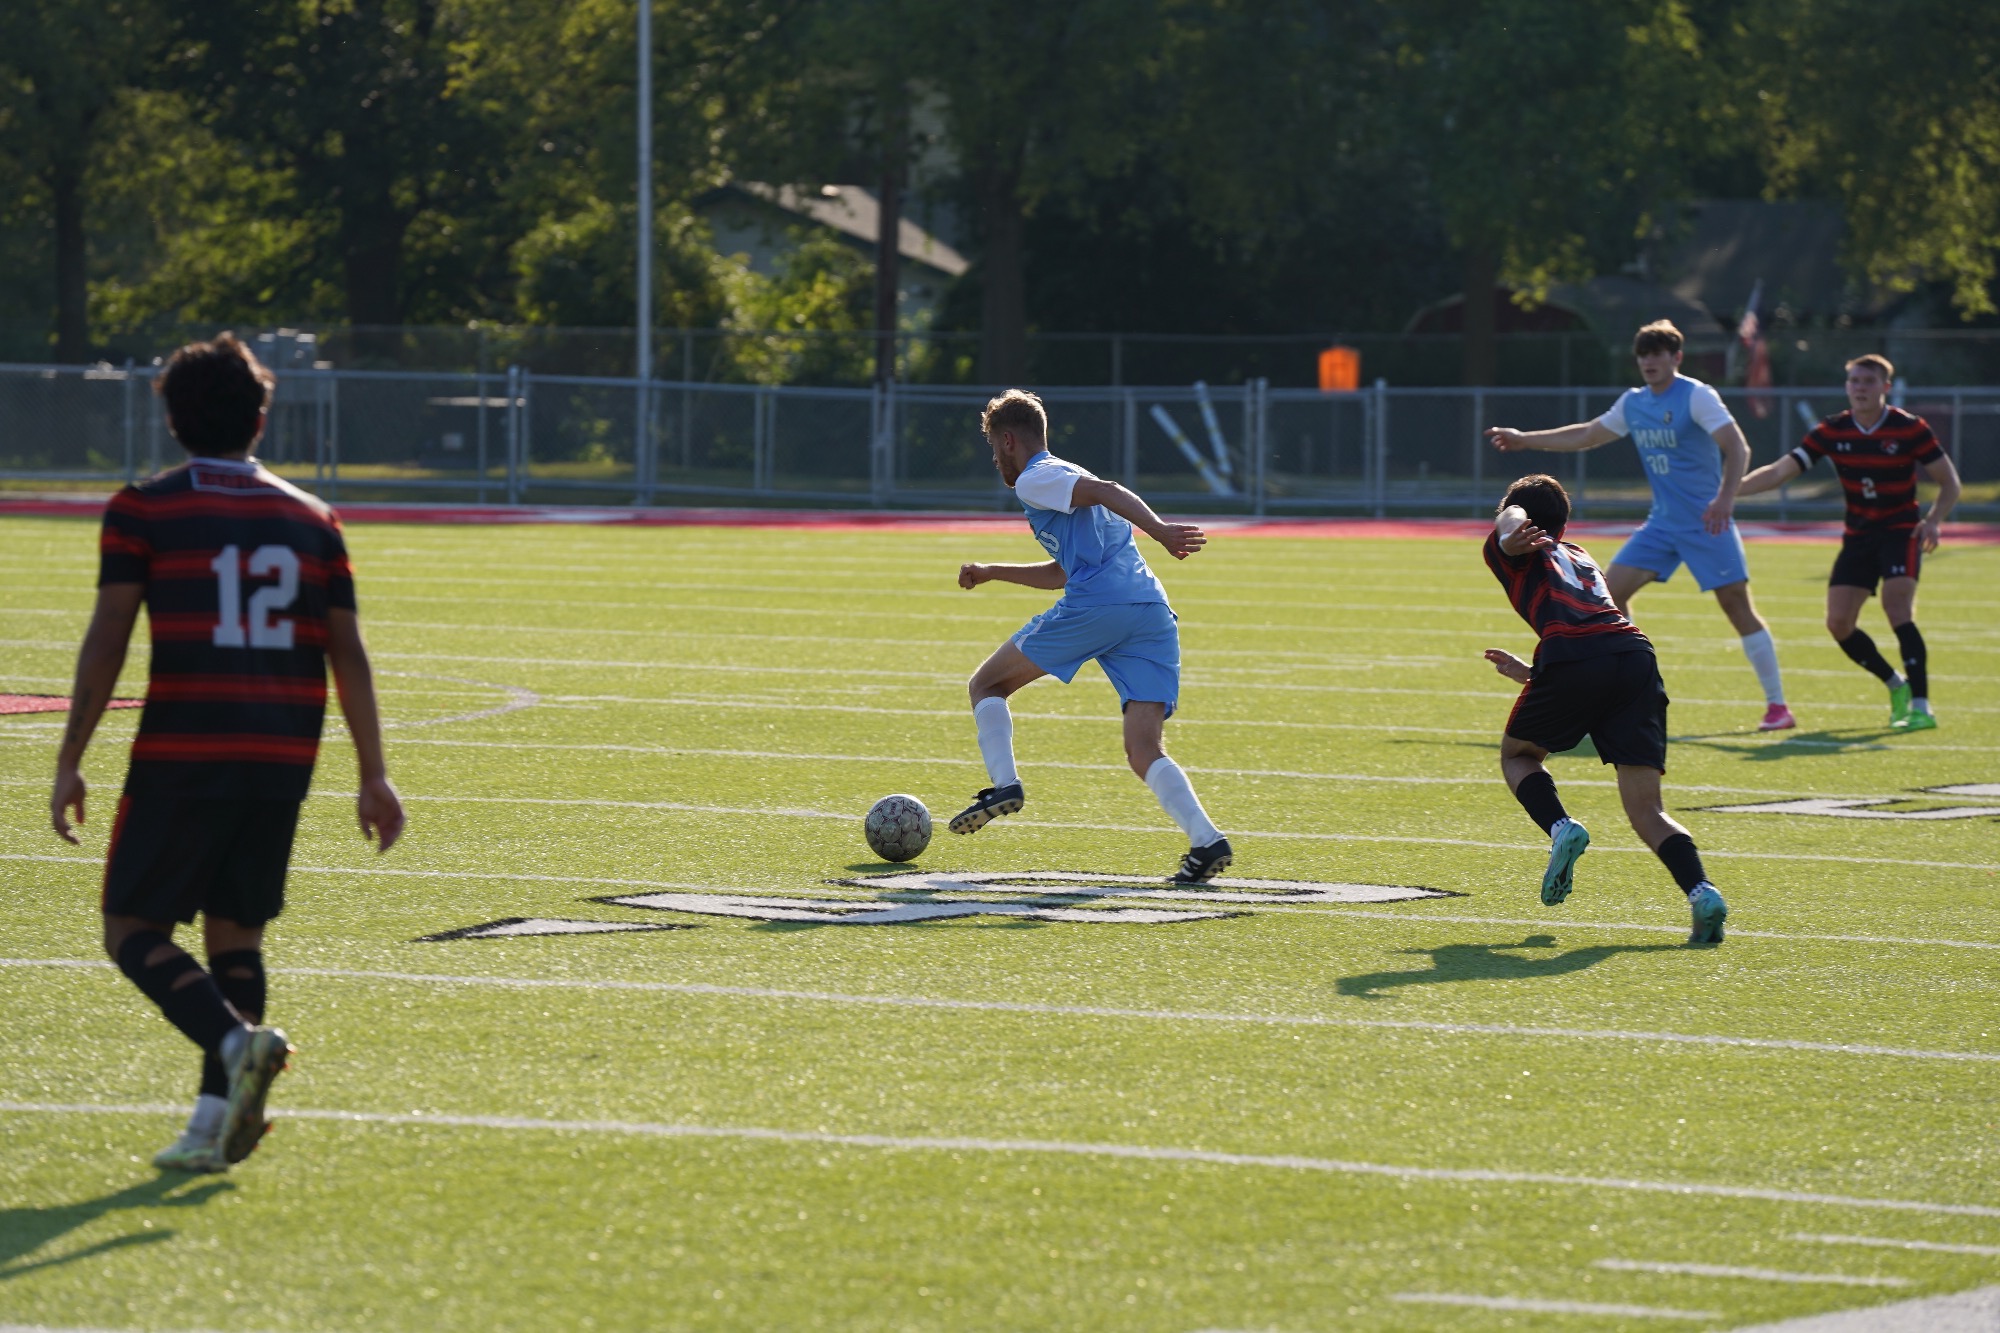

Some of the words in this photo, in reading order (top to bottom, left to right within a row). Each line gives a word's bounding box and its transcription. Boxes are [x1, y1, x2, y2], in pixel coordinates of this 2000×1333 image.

[1634, 428, 1677, 449] MMU
[1861, 477, 1877, 499] 2
[210, 543, 301, 650] 12
